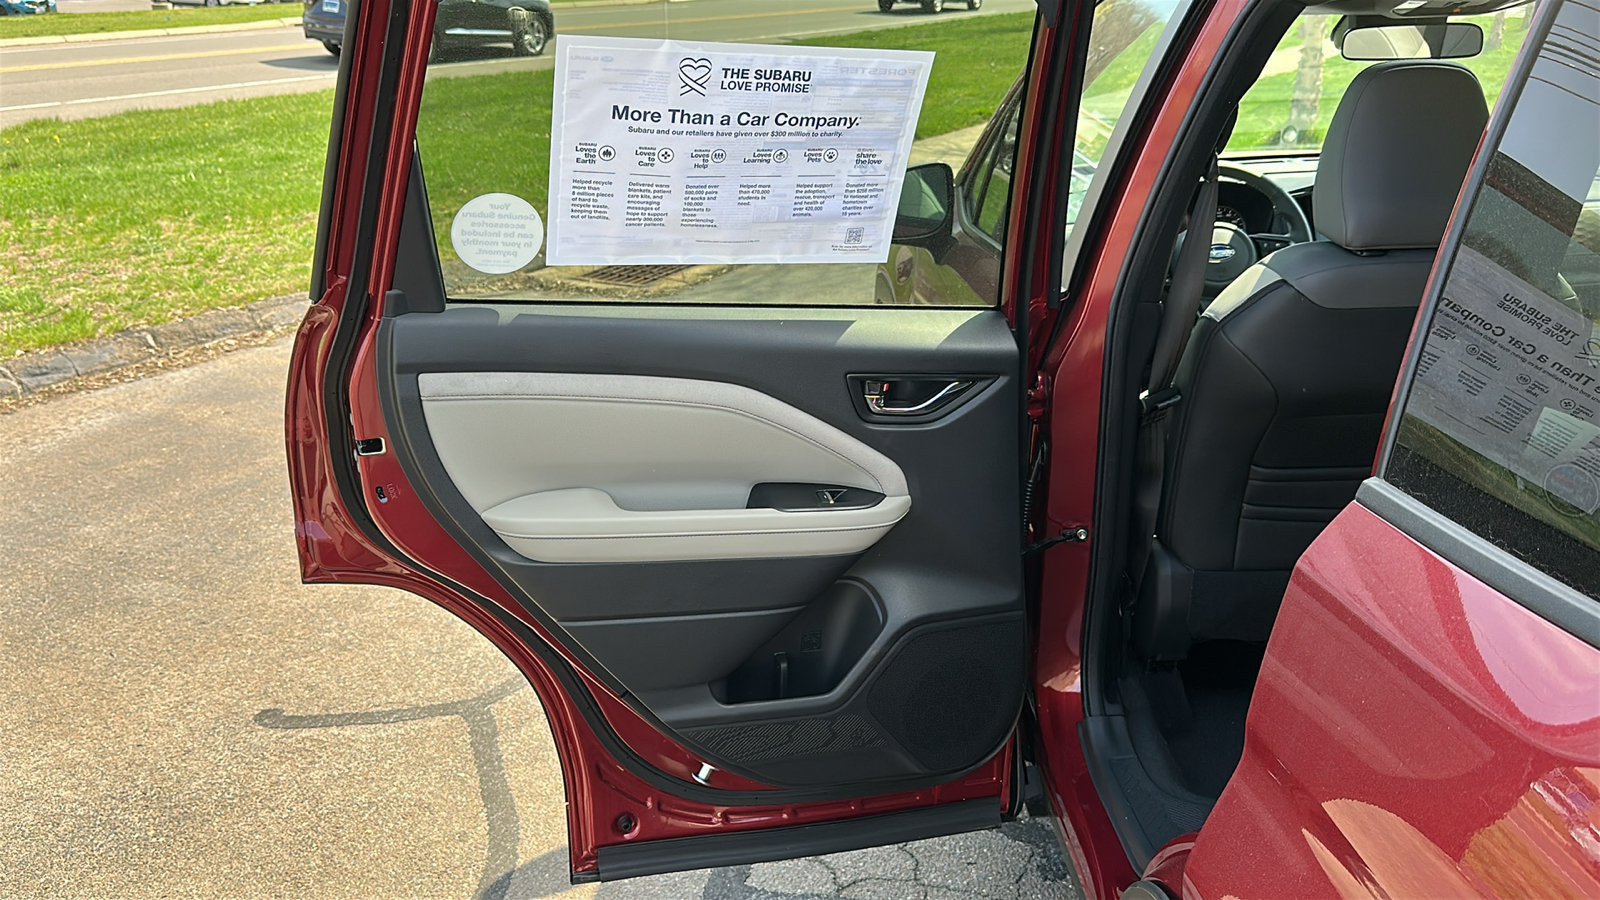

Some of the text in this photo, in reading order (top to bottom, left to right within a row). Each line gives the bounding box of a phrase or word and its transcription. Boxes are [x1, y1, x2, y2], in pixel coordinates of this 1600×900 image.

[722, 68, 812, 82] THE SUBARU
[720, 80, 752, 91] LOVE
[755, 82, 810, 93] PROMISE
[612, 104, 860, 130] More Than a Car Company.
[628, 126, 654, 134] Subaru
